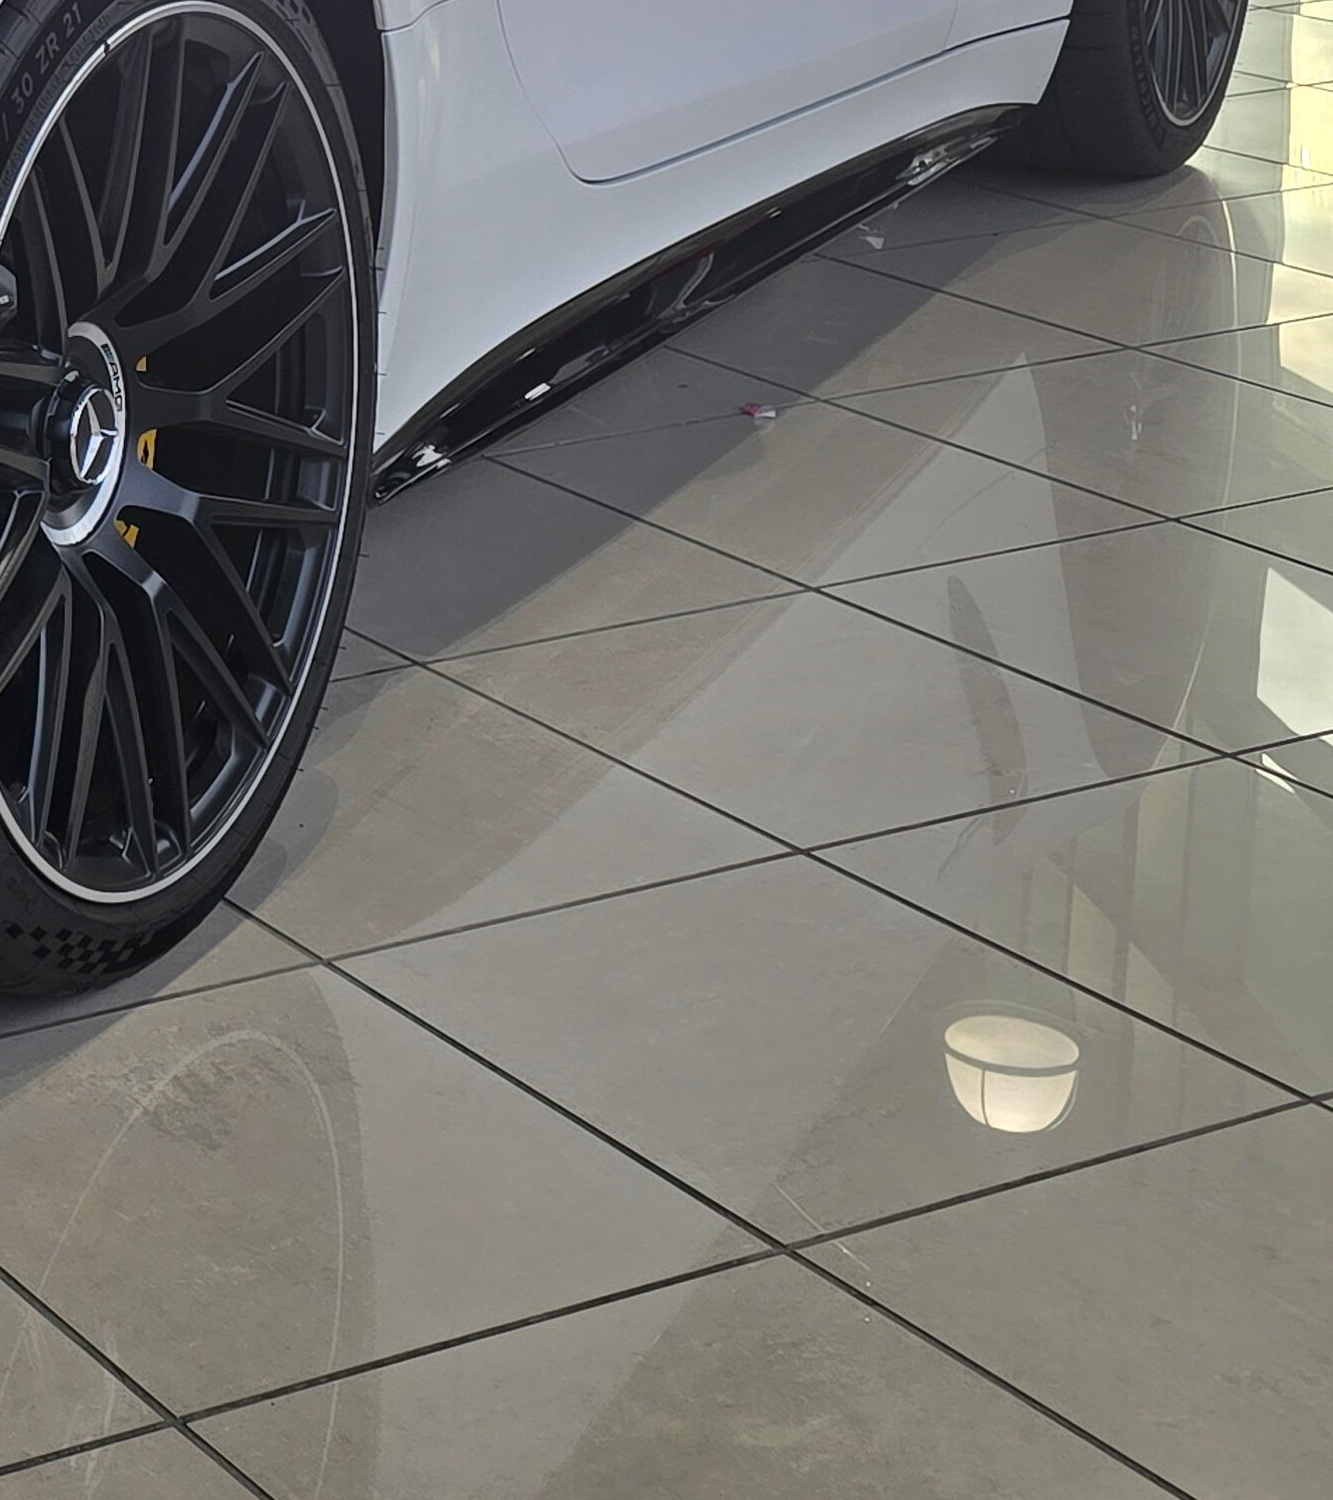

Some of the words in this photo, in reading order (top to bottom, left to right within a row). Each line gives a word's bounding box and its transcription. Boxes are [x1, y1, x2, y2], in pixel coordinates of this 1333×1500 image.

[11, 71, 35, 115] 30
[35, 31, 58, 74] ZR
[62, 1, 82, 38] 21
